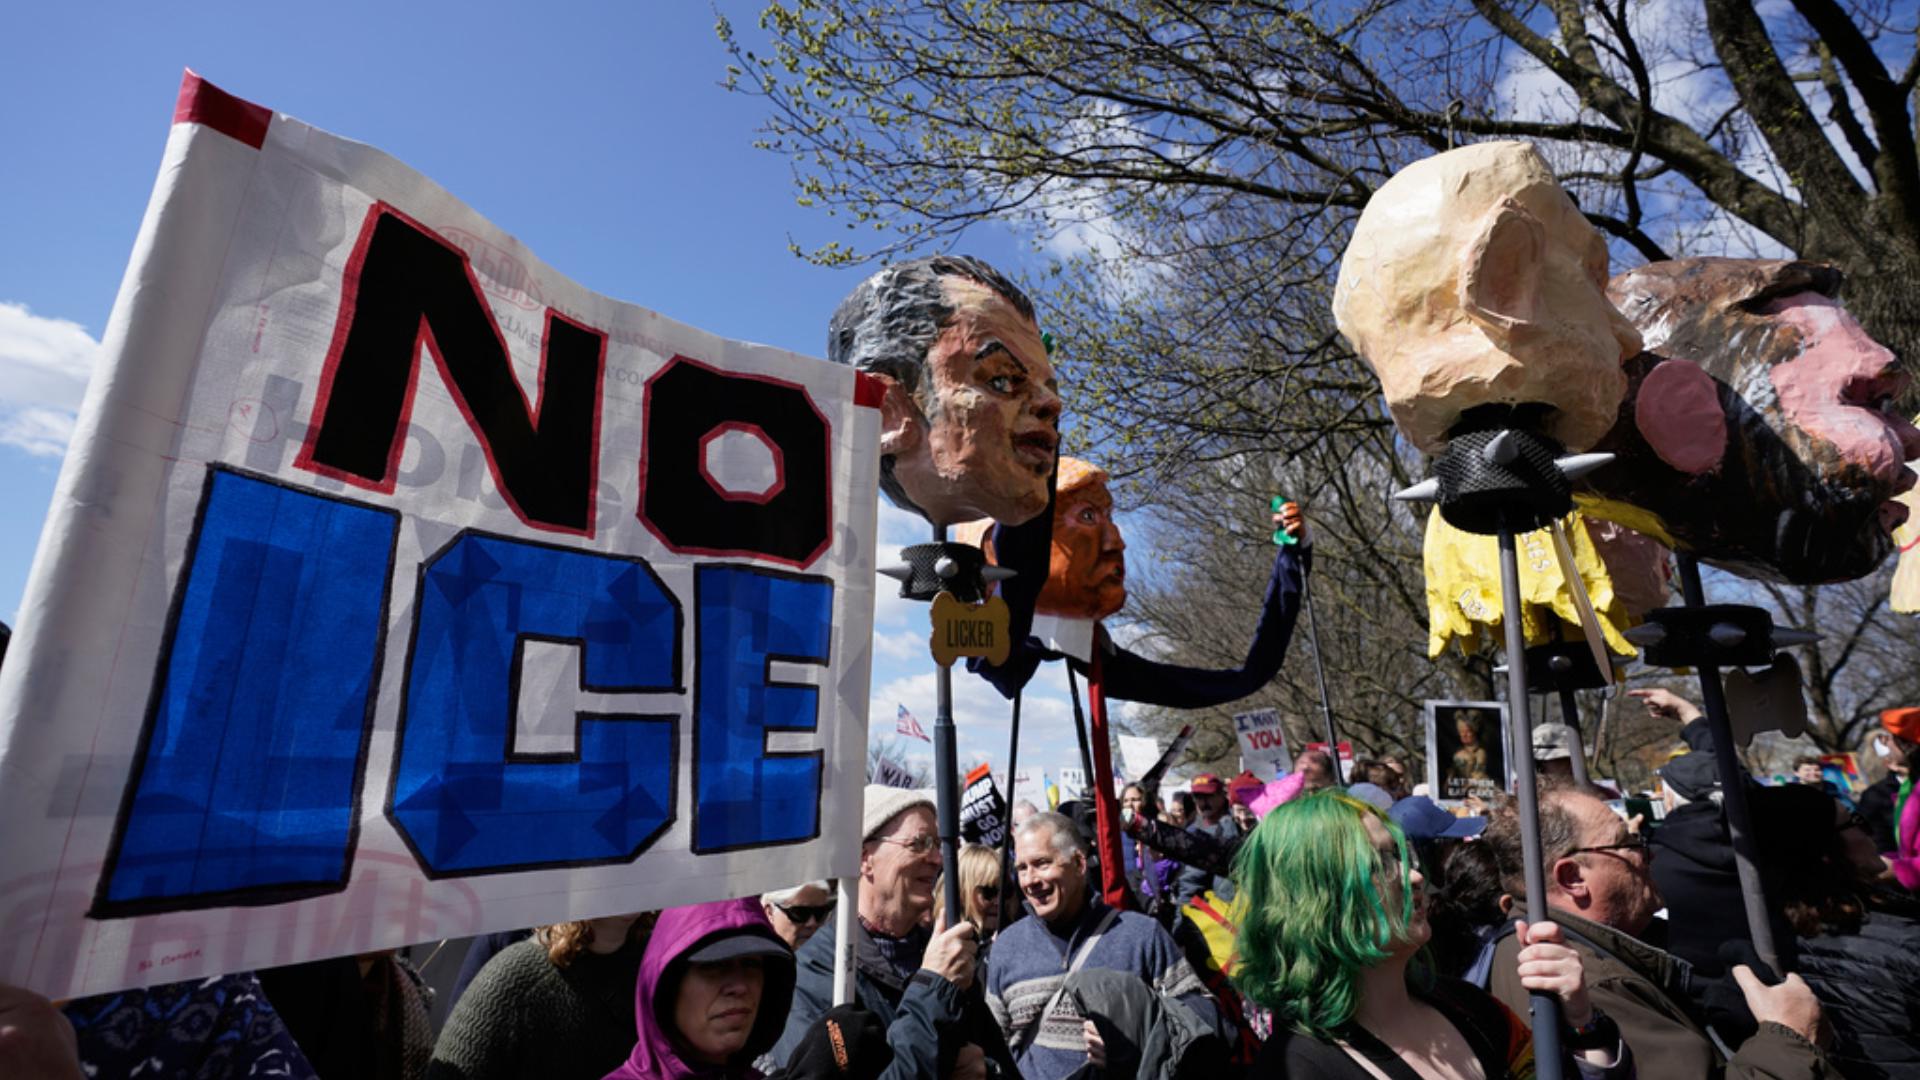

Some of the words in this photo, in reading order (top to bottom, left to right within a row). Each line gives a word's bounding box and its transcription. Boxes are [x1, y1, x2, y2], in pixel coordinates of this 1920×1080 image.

[293, 199, 833, 569] NO
[946, 619, 994, 649] LICKER
[88, 462, 833, 919] ICE
[1235, 715, 1249, 731] I
[1250, 710, 1279, 727] WANT
[1247, 729, 1282, 750] YOU
[881, 764, 913, 789] WAR
[959, 796, 997, 823] MUST
[976, 814, 998, 831] GO
